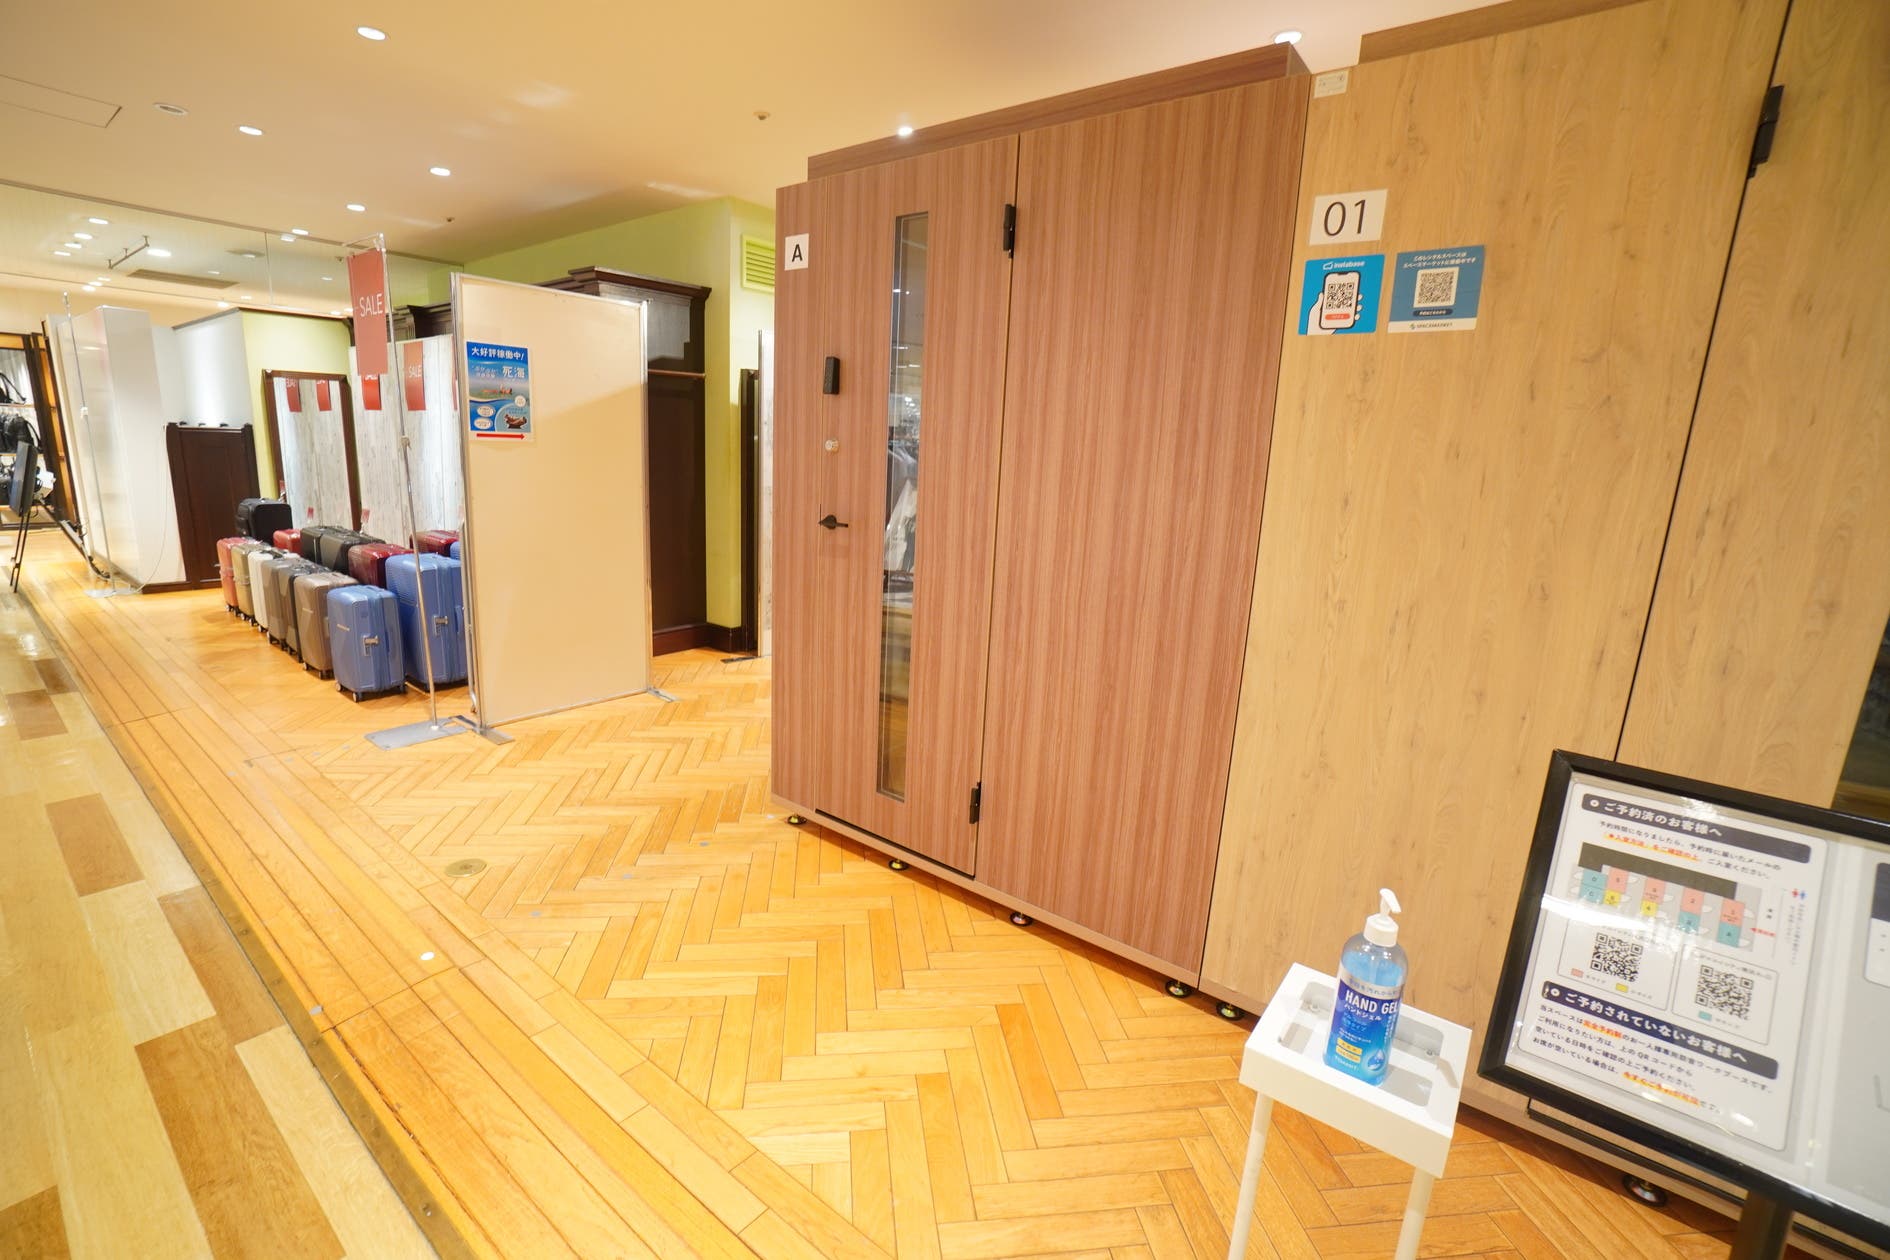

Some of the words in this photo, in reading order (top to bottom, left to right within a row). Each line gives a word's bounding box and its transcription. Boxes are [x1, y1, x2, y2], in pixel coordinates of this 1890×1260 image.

[1323, 199, 1367, 237] 01
[791, 243, 803, 263] A
[359, 293, 384, 317] SALE
[408, 364, 423, 379] SALE
[502, 365, 525, 379] 死海
[1603, 801, 1723, 838] ご予約済のお客様へ
[1343, 1003, 1382, 1021] ハンドジェル
[1345, 989, 1378, 1013] HAND
[1381, 999, 1399, 1016] GEL
[1564, 992, 1749, 1063] ご予約されていないお客様へ
